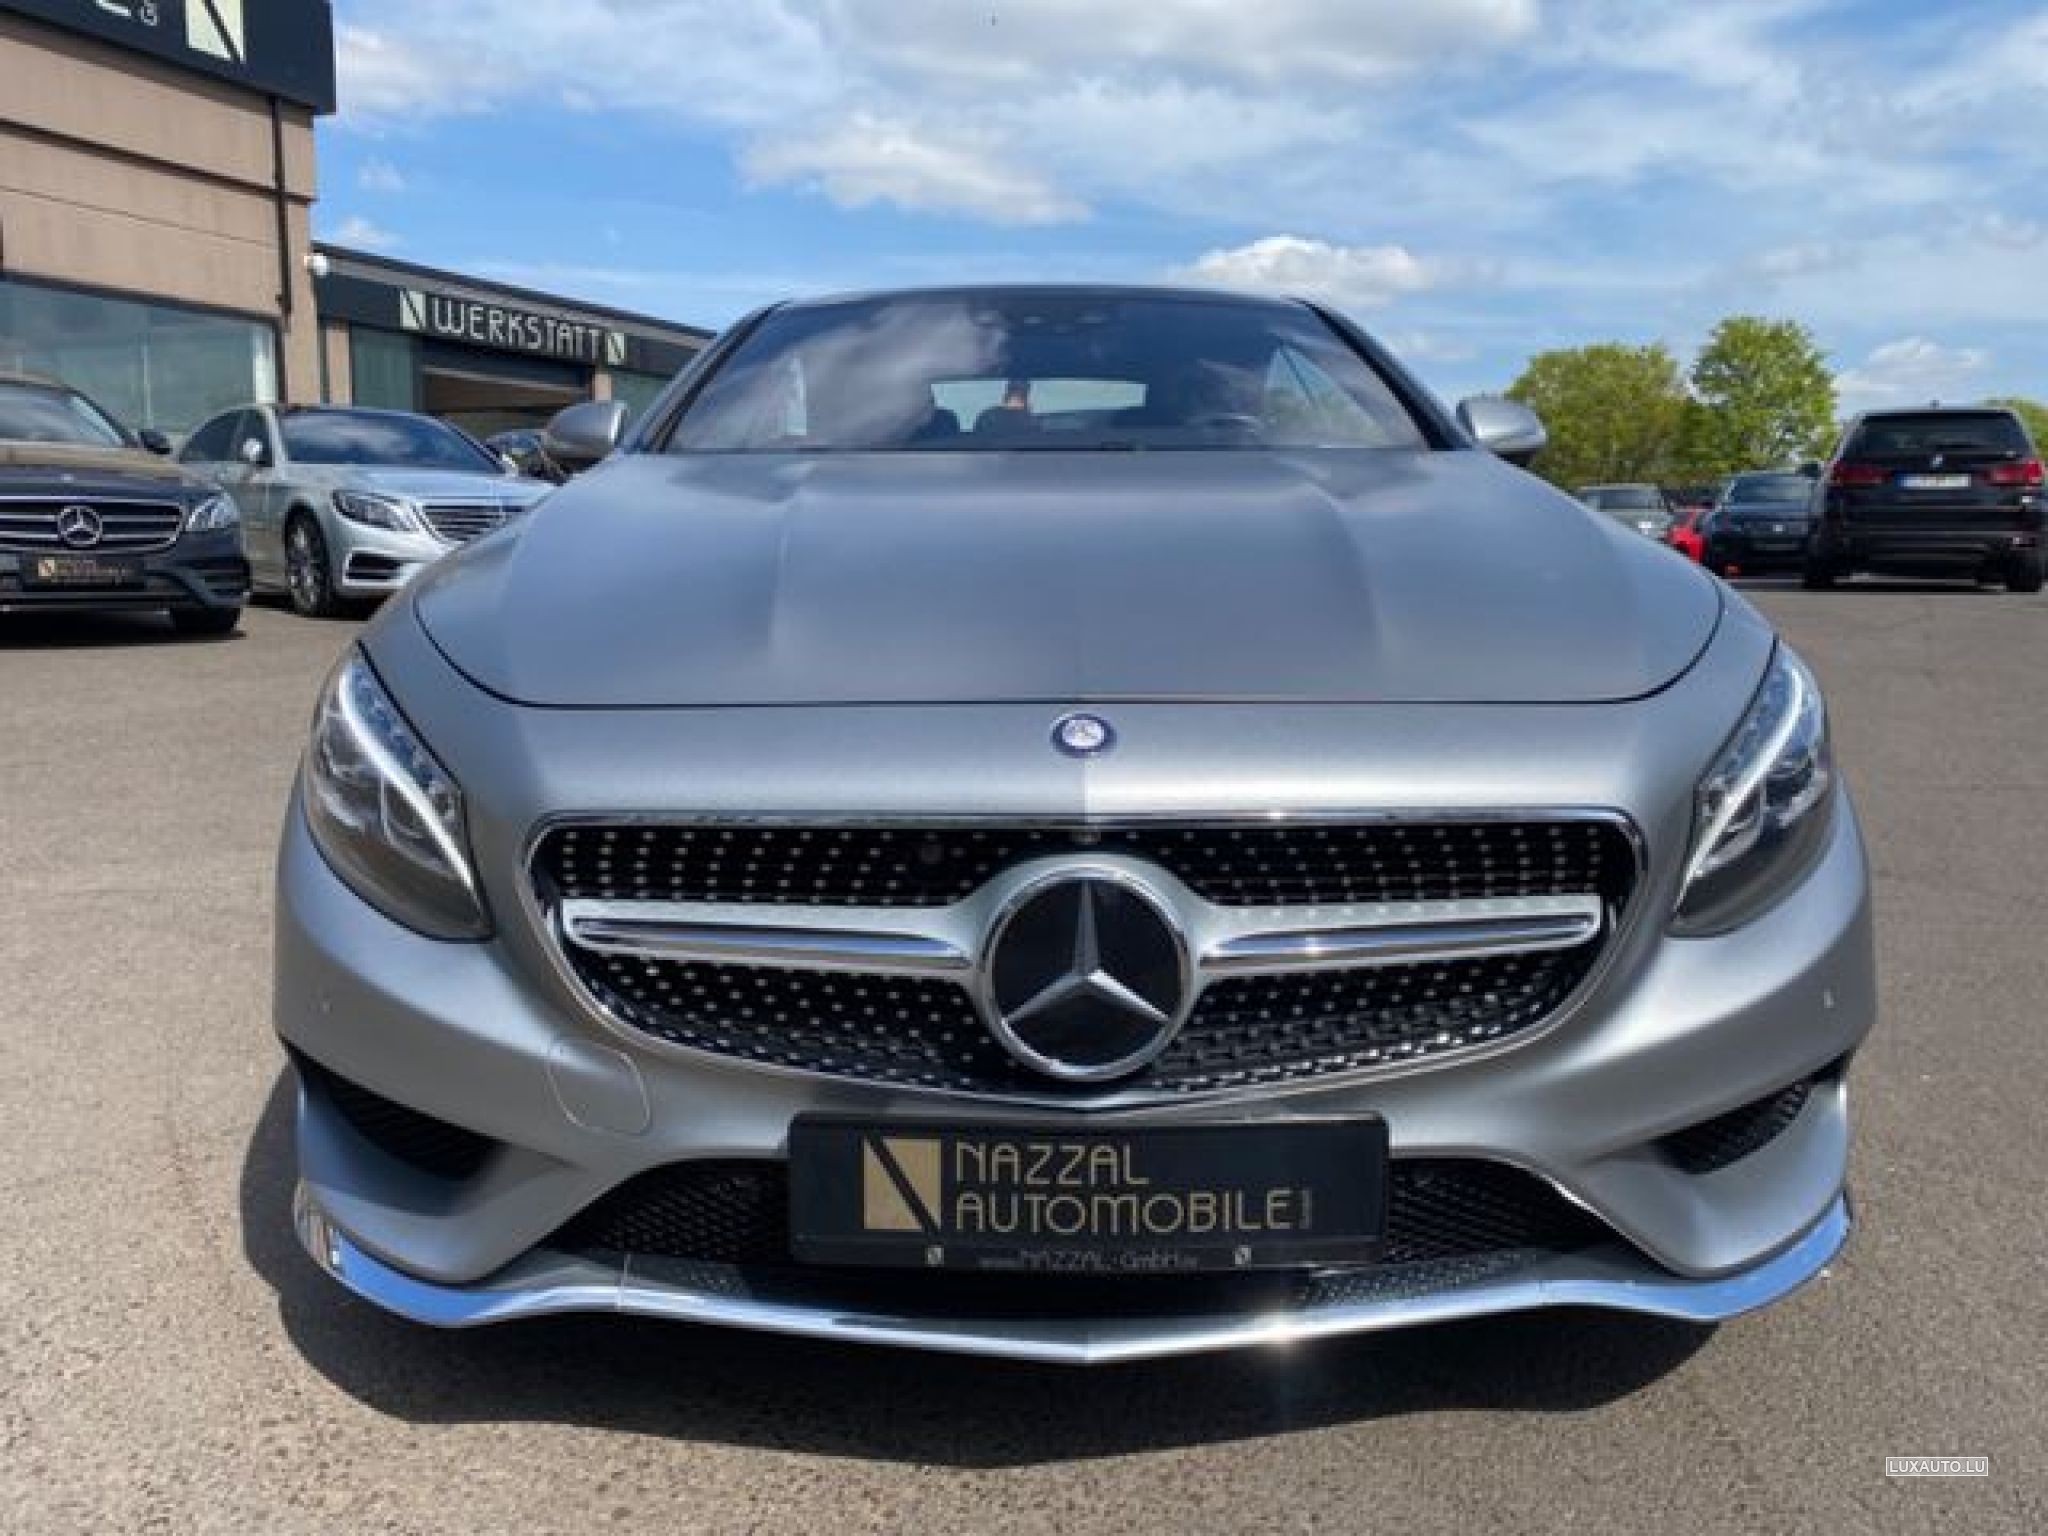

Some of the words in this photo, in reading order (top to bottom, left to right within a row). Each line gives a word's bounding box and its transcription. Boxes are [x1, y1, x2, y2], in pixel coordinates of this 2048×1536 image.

[434, 297, 601, 360] WERKSTATT
[955, 1142, 1150, 1185] NAZZAL
[955, 1188, 1292, 1234] AUTOMOBILE
